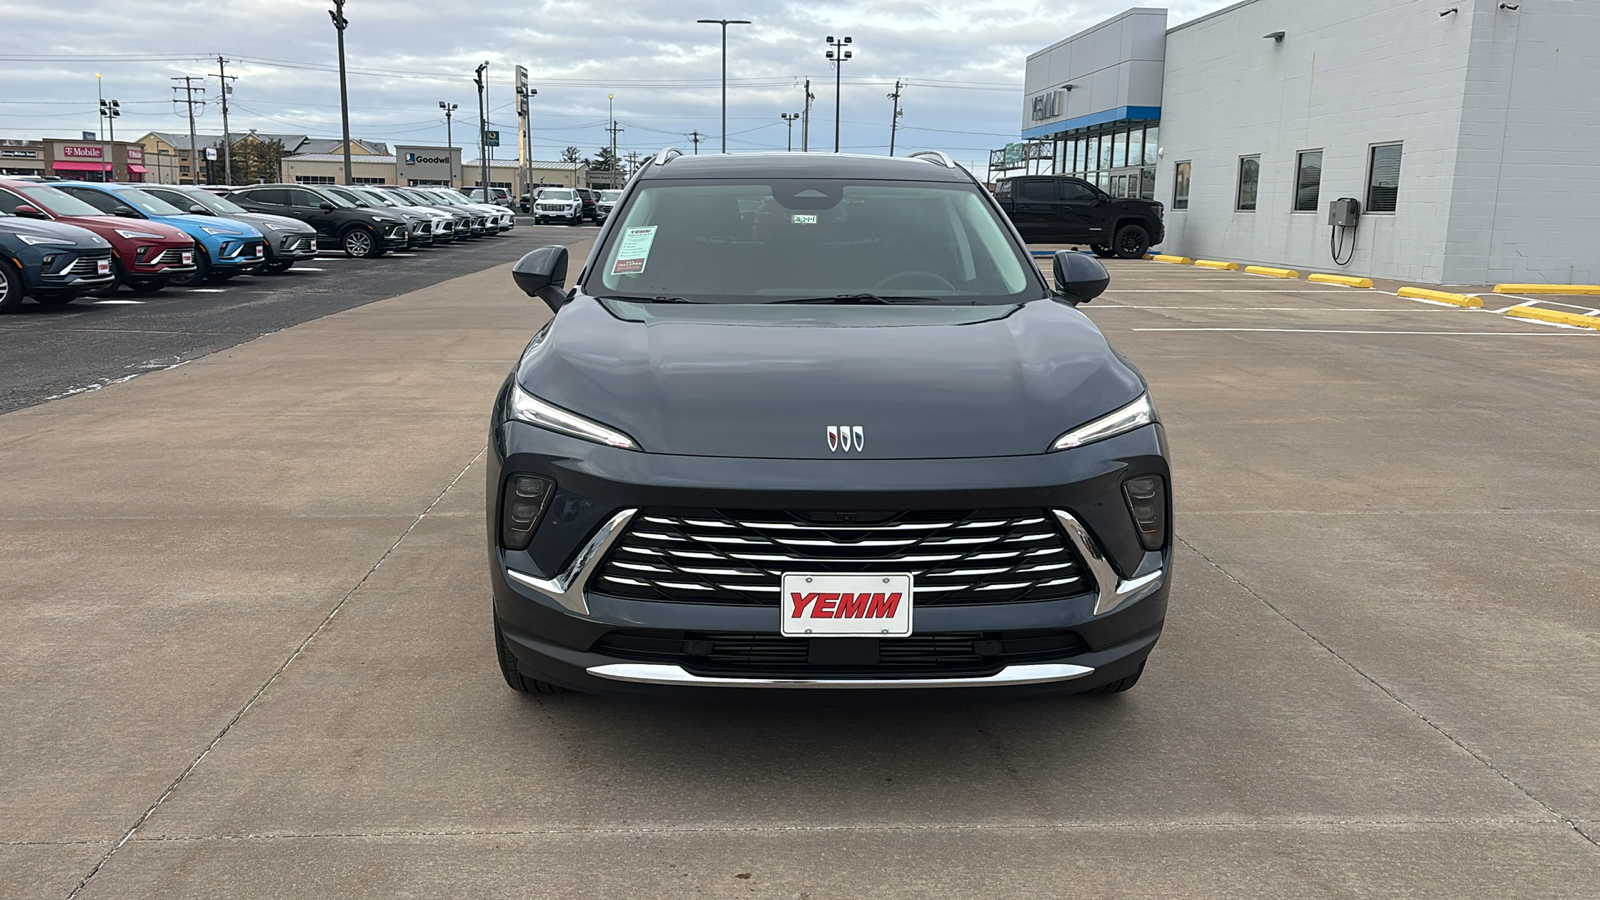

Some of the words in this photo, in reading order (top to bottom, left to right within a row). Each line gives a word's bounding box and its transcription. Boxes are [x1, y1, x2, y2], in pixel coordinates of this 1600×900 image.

[73, 147, 100, 157] Mobile
[416, 156, 450, 164] Goodwil
[790, 592, 903, 619] YEMM
